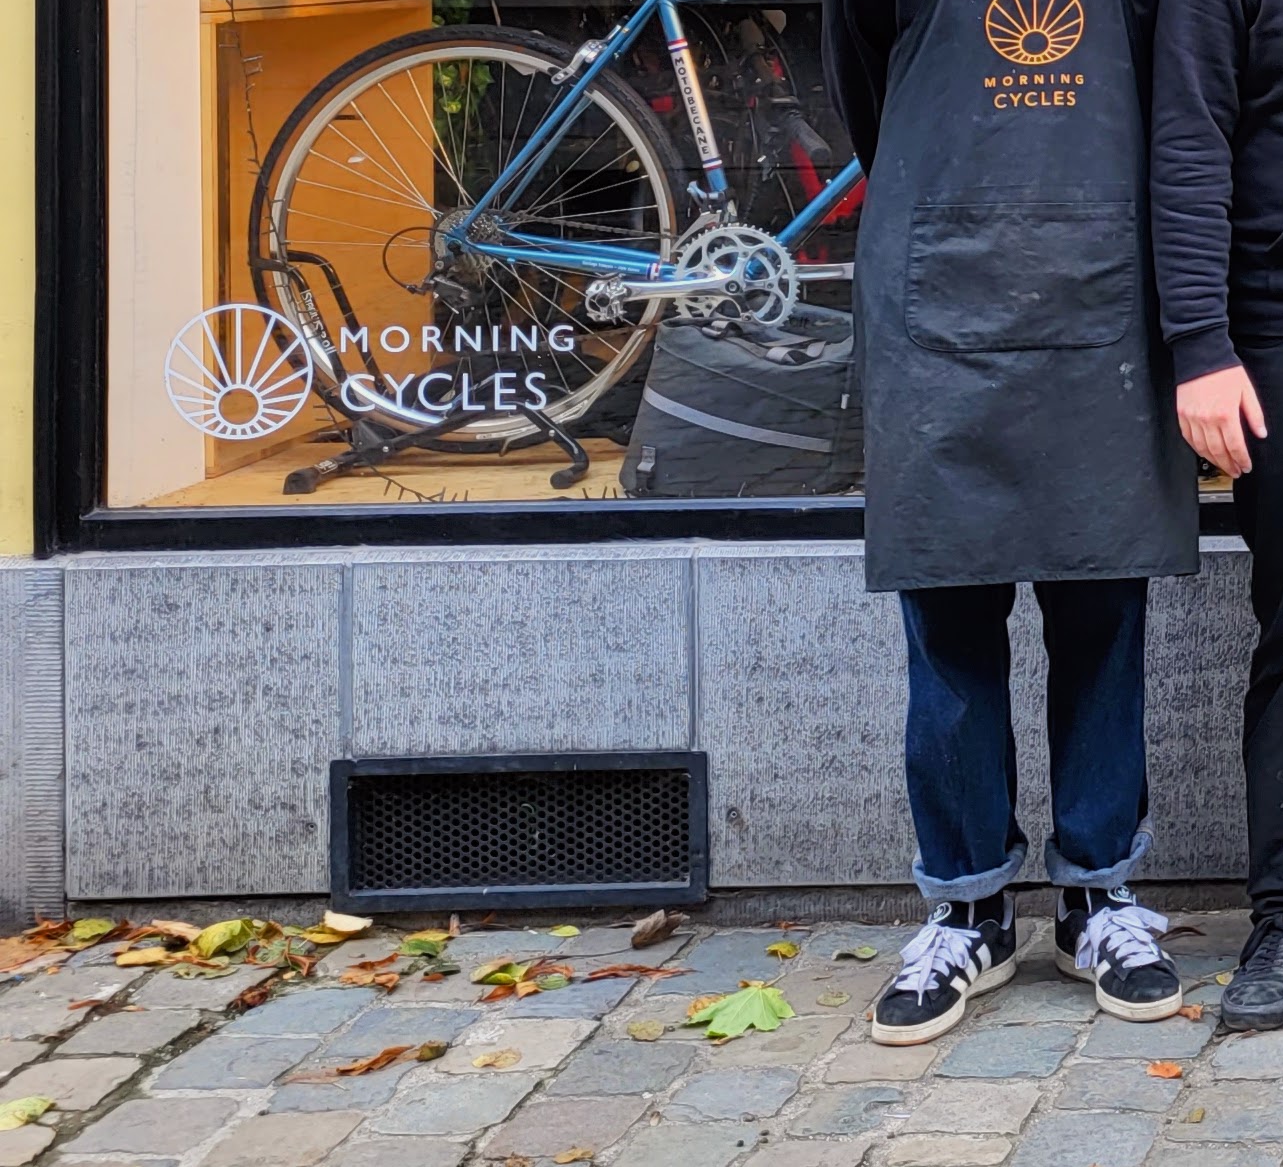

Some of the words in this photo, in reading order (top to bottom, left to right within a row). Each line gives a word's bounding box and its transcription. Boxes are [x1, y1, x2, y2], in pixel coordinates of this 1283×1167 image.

[984, 74, 1084, 88] MORNING
[674, 56, 709, 155] MOTOBECANE
[994, 91, 1076, 109] CYCLES
[340, 325, 575, 353] MORNING
[340, 372, 548, 412] CYCLES
